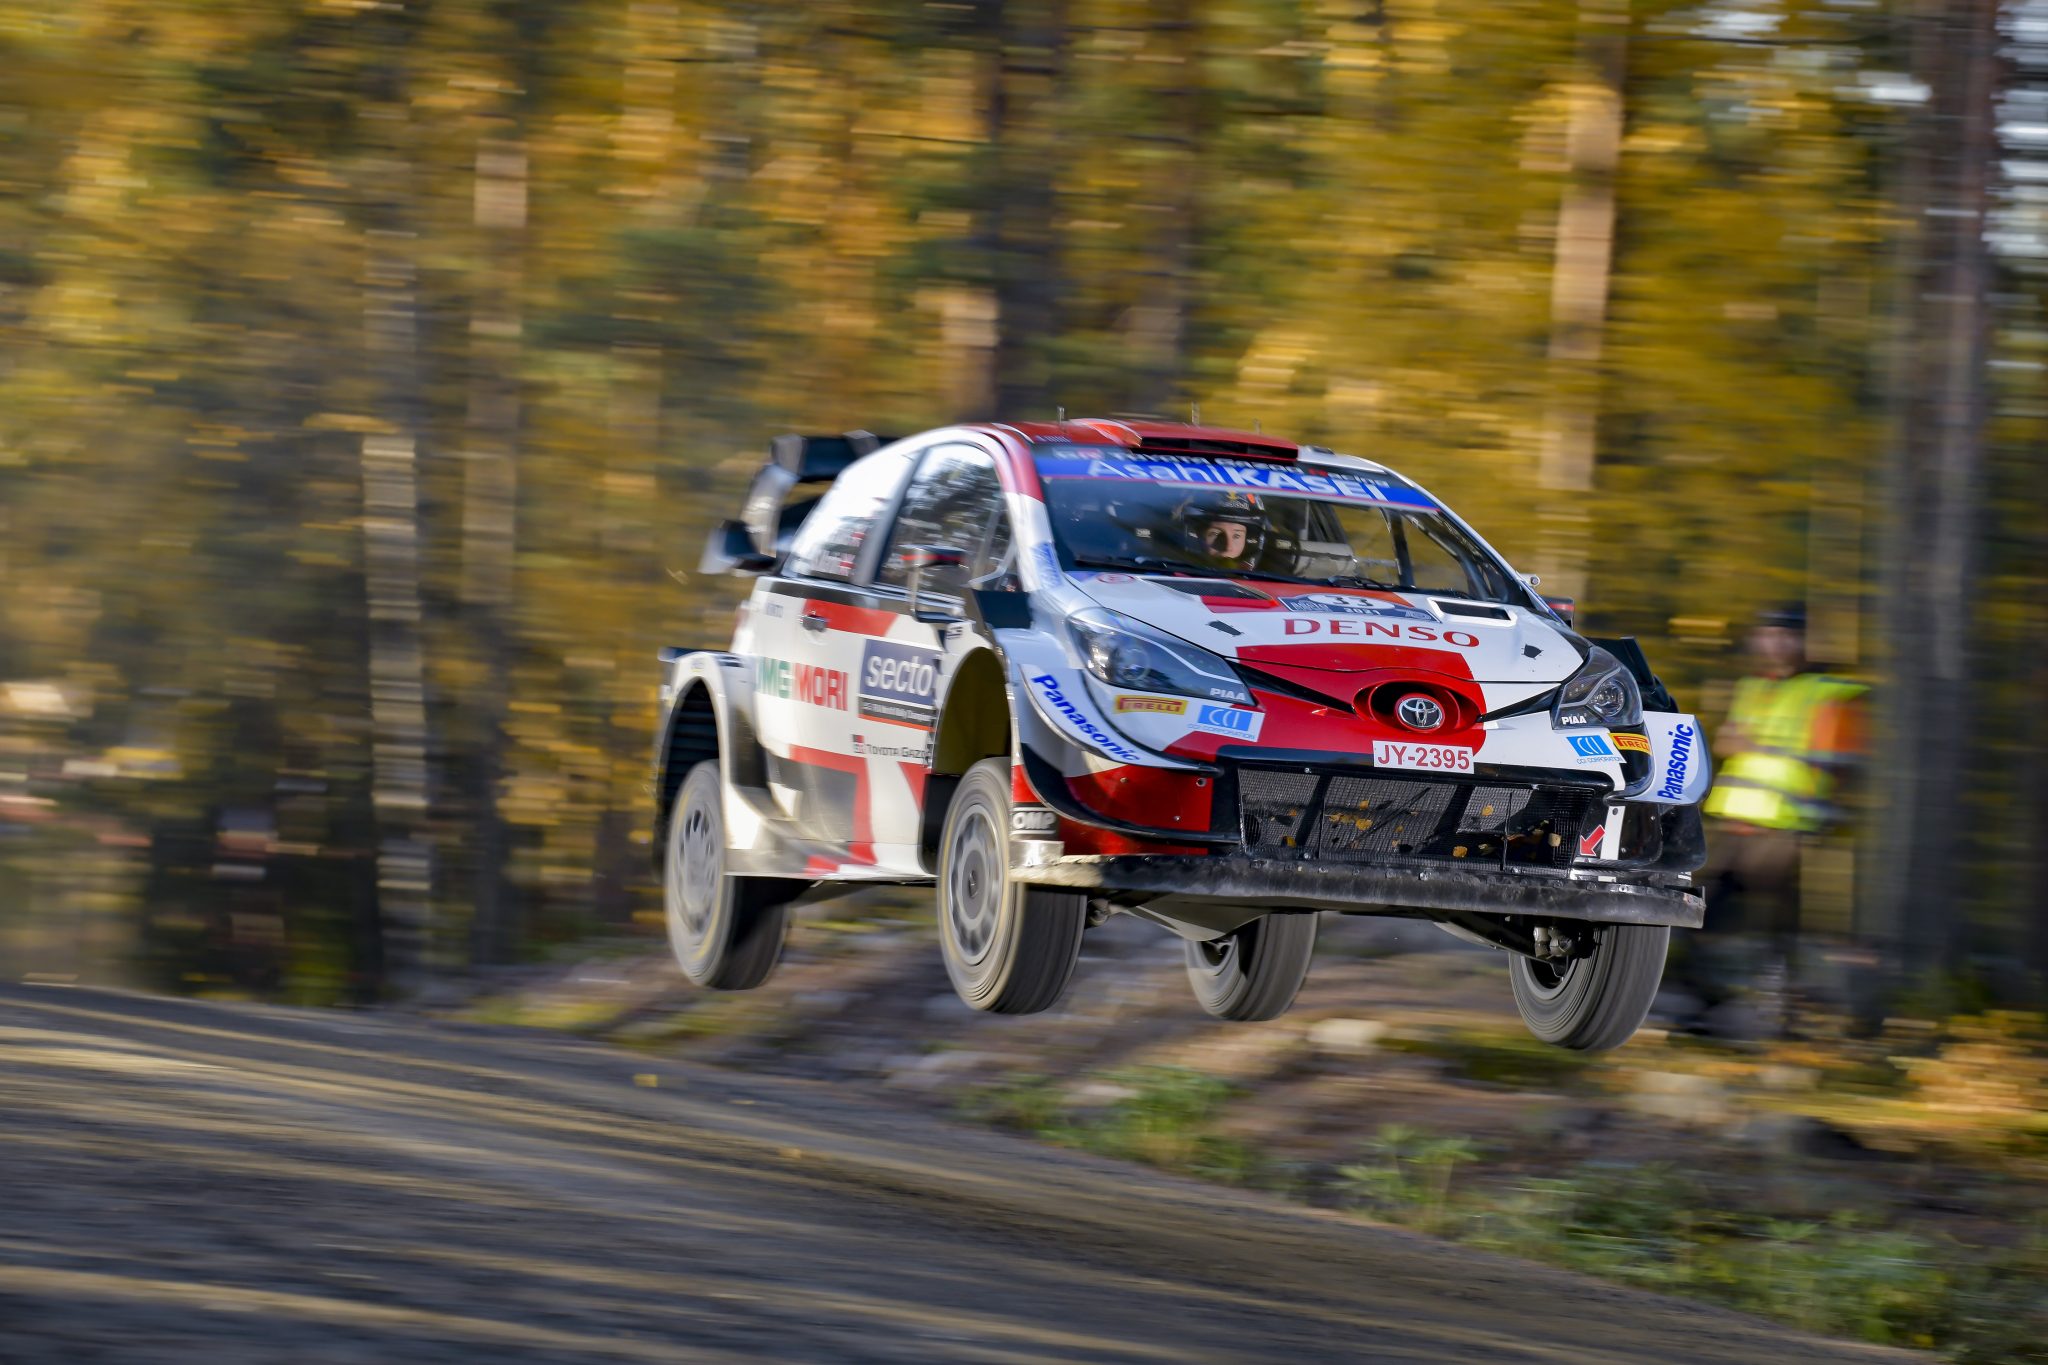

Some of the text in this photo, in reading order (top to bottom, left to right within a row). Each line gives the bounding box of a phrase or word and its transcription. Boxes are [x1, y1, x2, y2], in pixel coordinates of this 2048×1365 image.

[1332, 594, 1374, 607] 33
[1283, 618, 1480, 648] DENSO
[794, 662, 849, 711] MORI
[865, 655, 934, 697] secto
[1118, 697, 1183, 712] PIRELLI
[1209, 687, 1246, 701] PIAA
[1031, 674, 1140, 761] Panasonic
[1561, 715, 1587, 725] PIAA
[1377, 744, 1470, 771] JY-2395
[1657, 723, 1694, 801] Panasonic
[1012, 811, 1055, 830] OMP
